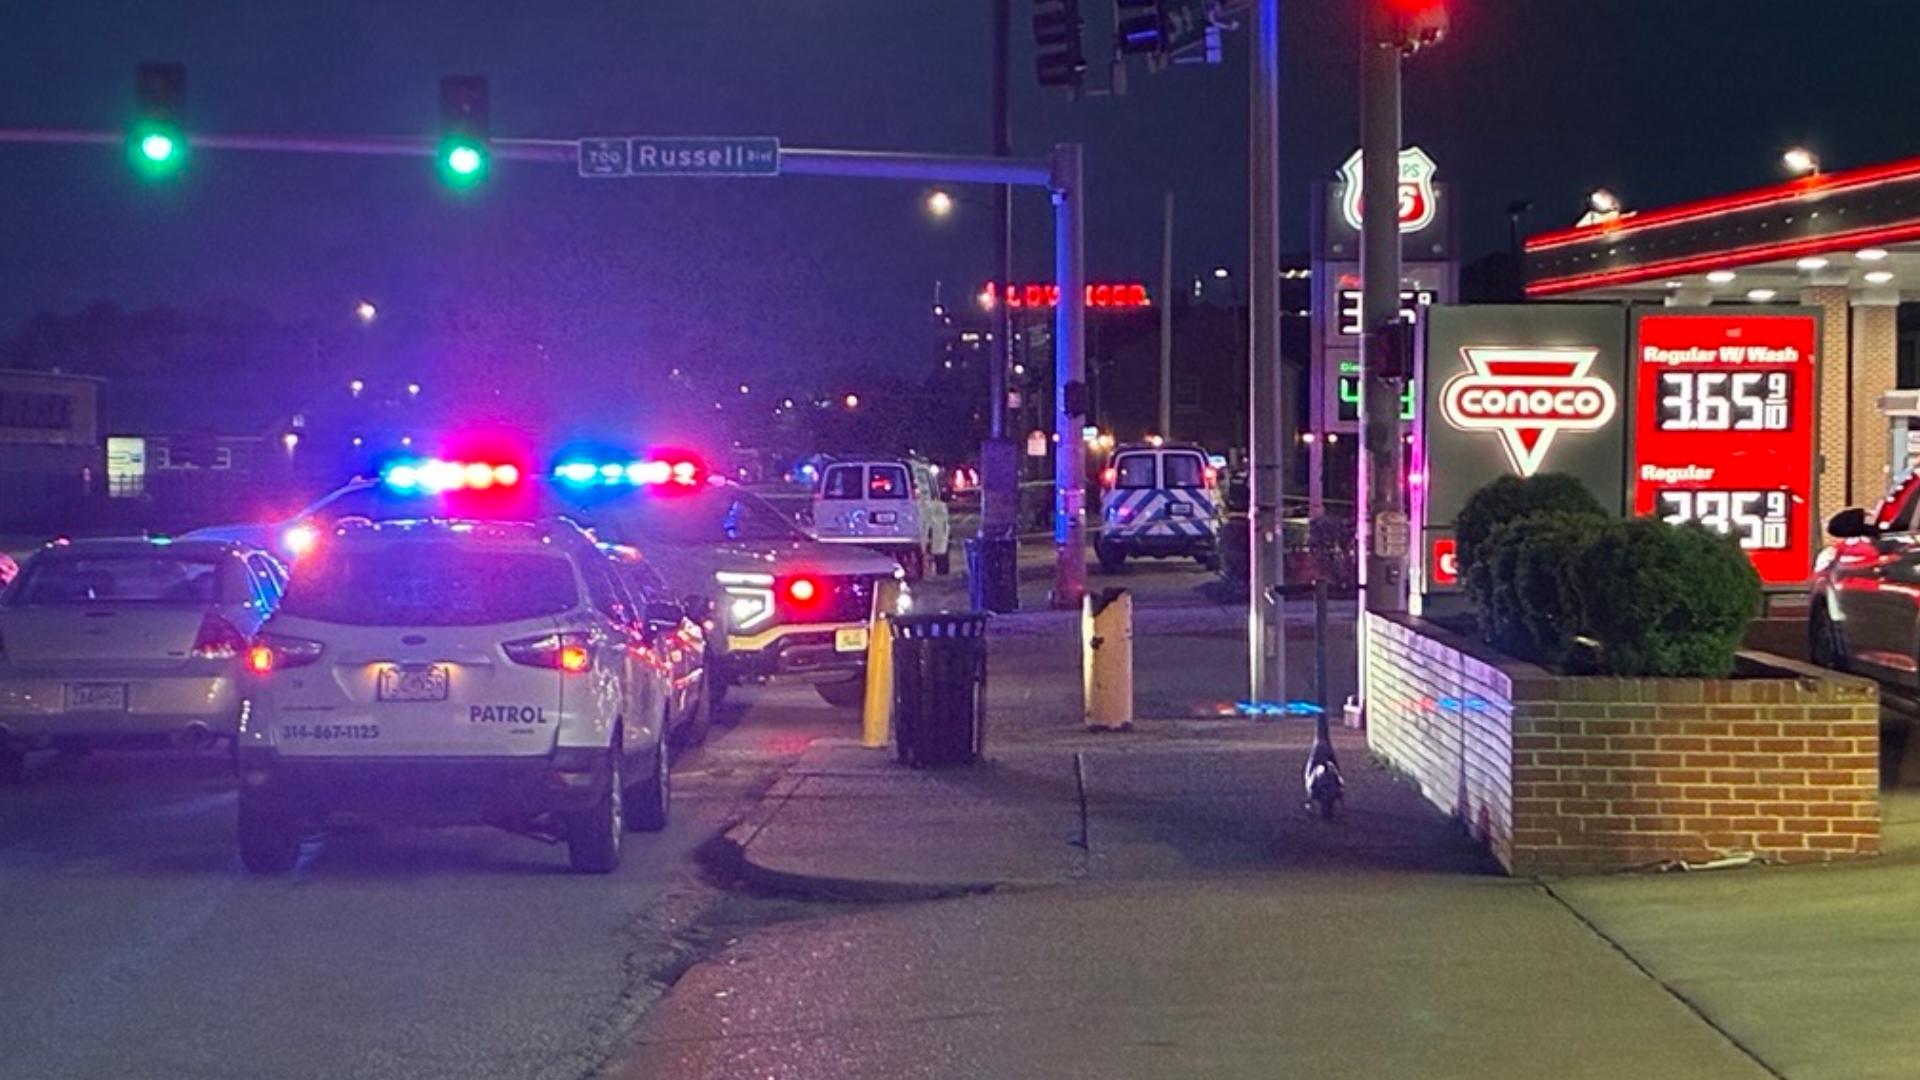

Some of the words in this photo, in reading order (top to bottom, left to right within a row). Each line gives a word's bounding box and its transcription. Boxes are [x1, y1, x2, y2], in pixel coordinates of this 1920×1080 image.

[640, 145, 743, 167] Russell
[1643, 346, 1717, 365] Regular
[1747, 346, 1799, 363] Wash
[1641, 464, 1715, 483] Regular
[470, 705, 547, 724] PATROL
